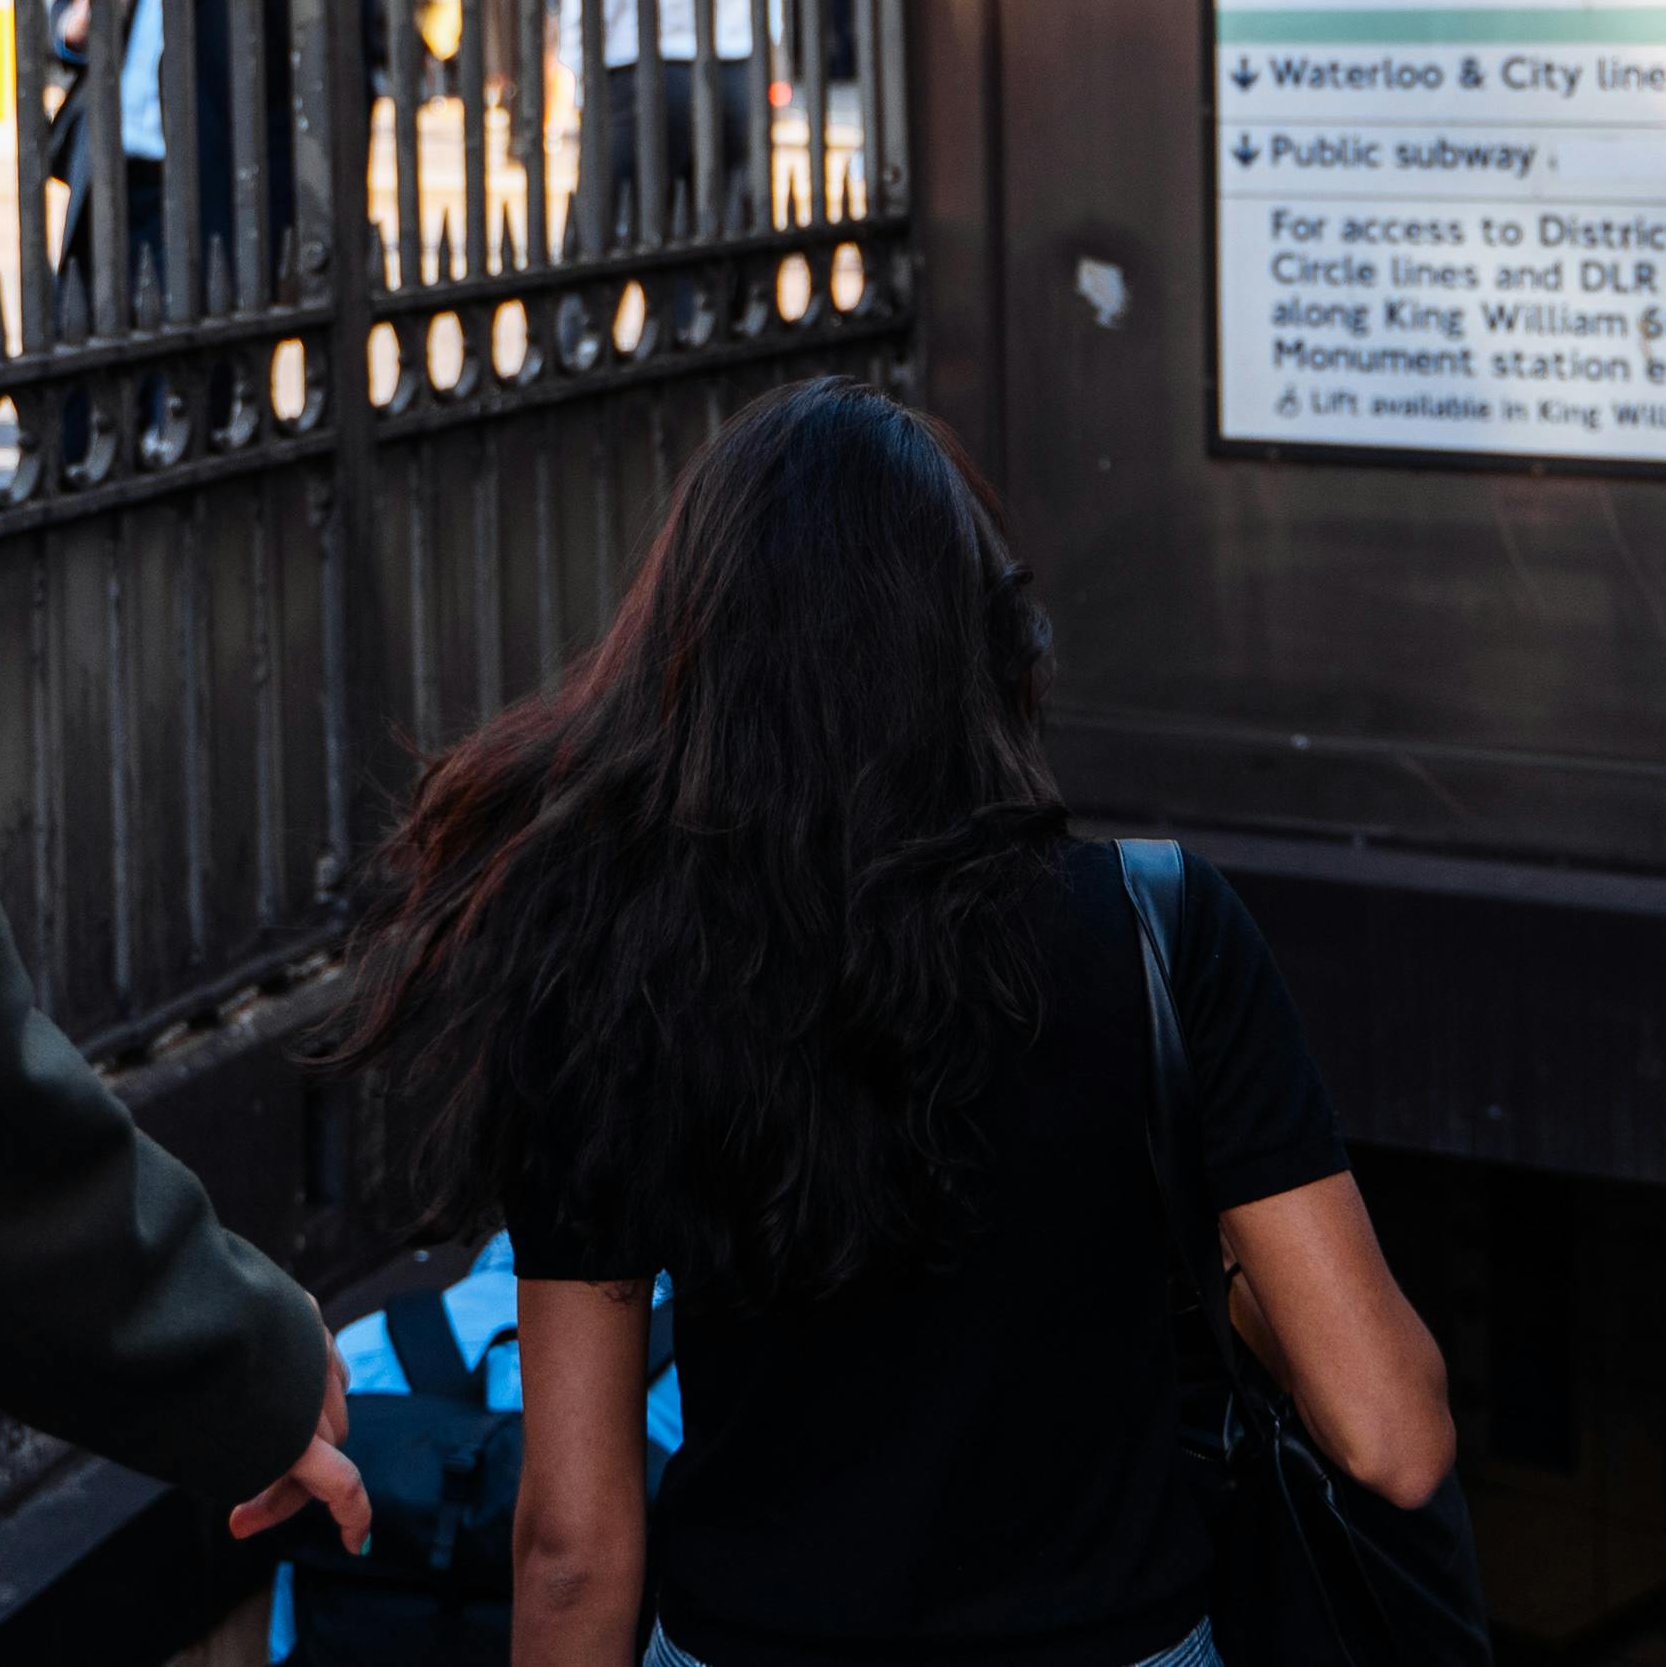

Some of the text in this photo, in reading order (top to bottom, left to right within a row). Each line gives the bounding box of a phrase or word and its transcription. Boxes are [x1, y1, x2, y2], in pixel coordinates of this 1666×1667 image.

[1270, 56, 1444, 91] Waterloo
[1458, 56, 1485, 91] &
[1501, 56, 1582, 99] City
[1270, 135, 1537, 179] Public subway
[1272, 209, 1326, 242] For
[1341, 215, 1465, 246] access
[1481, 216, 1524, 247] to
[1272, 252, 1376, 287] Circle
[1390, 256, 1479, 289] lines
[1495, 259, 1563, 291] and
[1581, 260, 1658, 295] DLR
[1272, 295, 1369, 338] along
[1384, 298, 1466, 340] King
[1482, 301, 1628, 338] William
[1273, 338, 1475, 378] Monument
[1491, 349, 1631, 384] station
[1310, 387, 1358, 415] Lift
[1372, 394, 1491, 422] available
[1501, 398, 1530, 421] in
[1538, 399, 1600, 430] King
